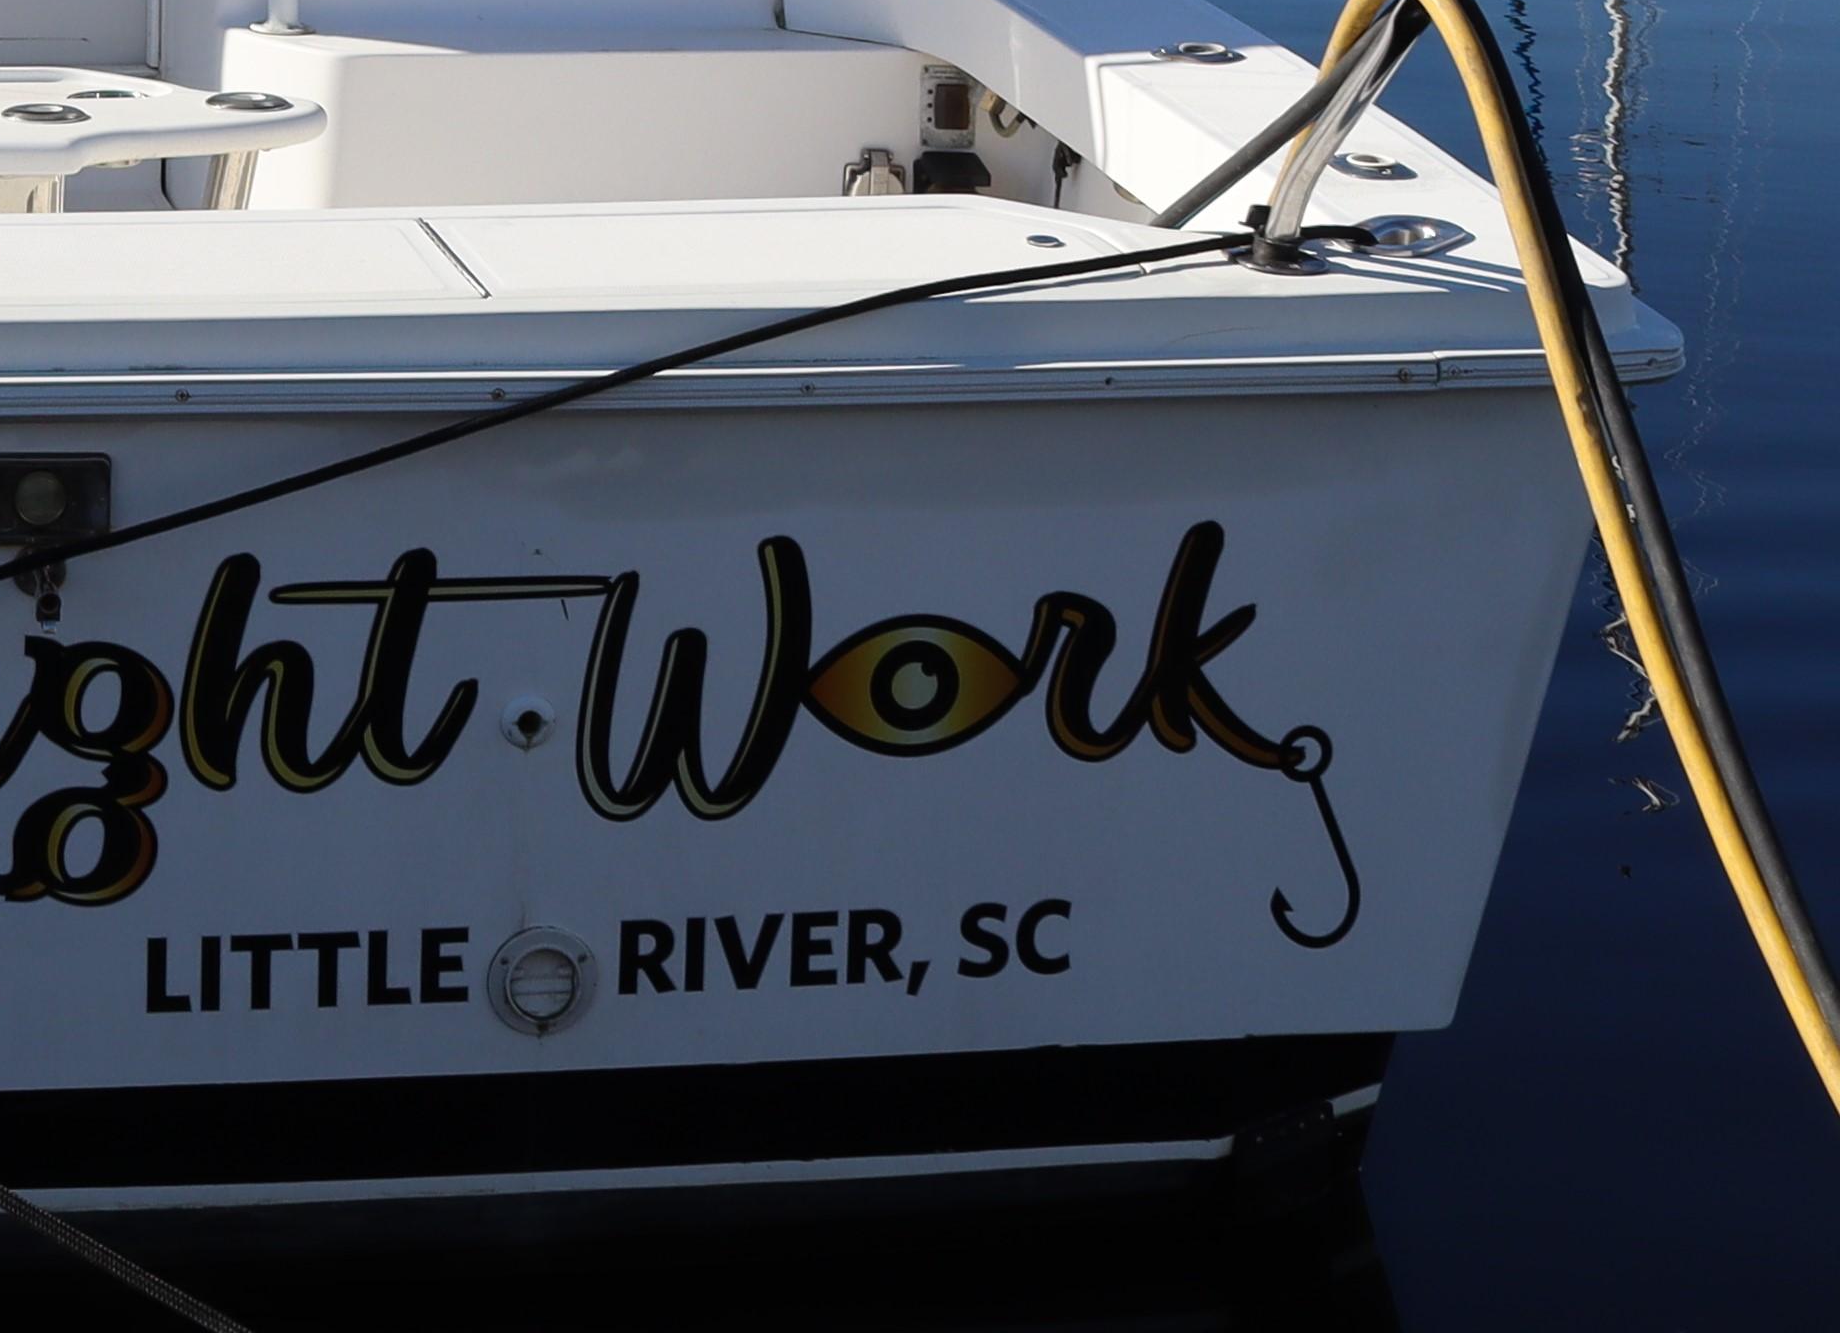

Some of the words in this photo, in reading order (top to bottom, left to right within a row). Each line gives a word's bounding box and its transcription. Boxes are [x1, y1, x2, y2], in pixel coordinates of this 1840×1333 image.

[575, 519, 1306, 823] Work
[145, 926, 470, 1014] LITTLE
[617, 908, 931, 996] RIVER,
[957, 898, 1072, 979] SC
